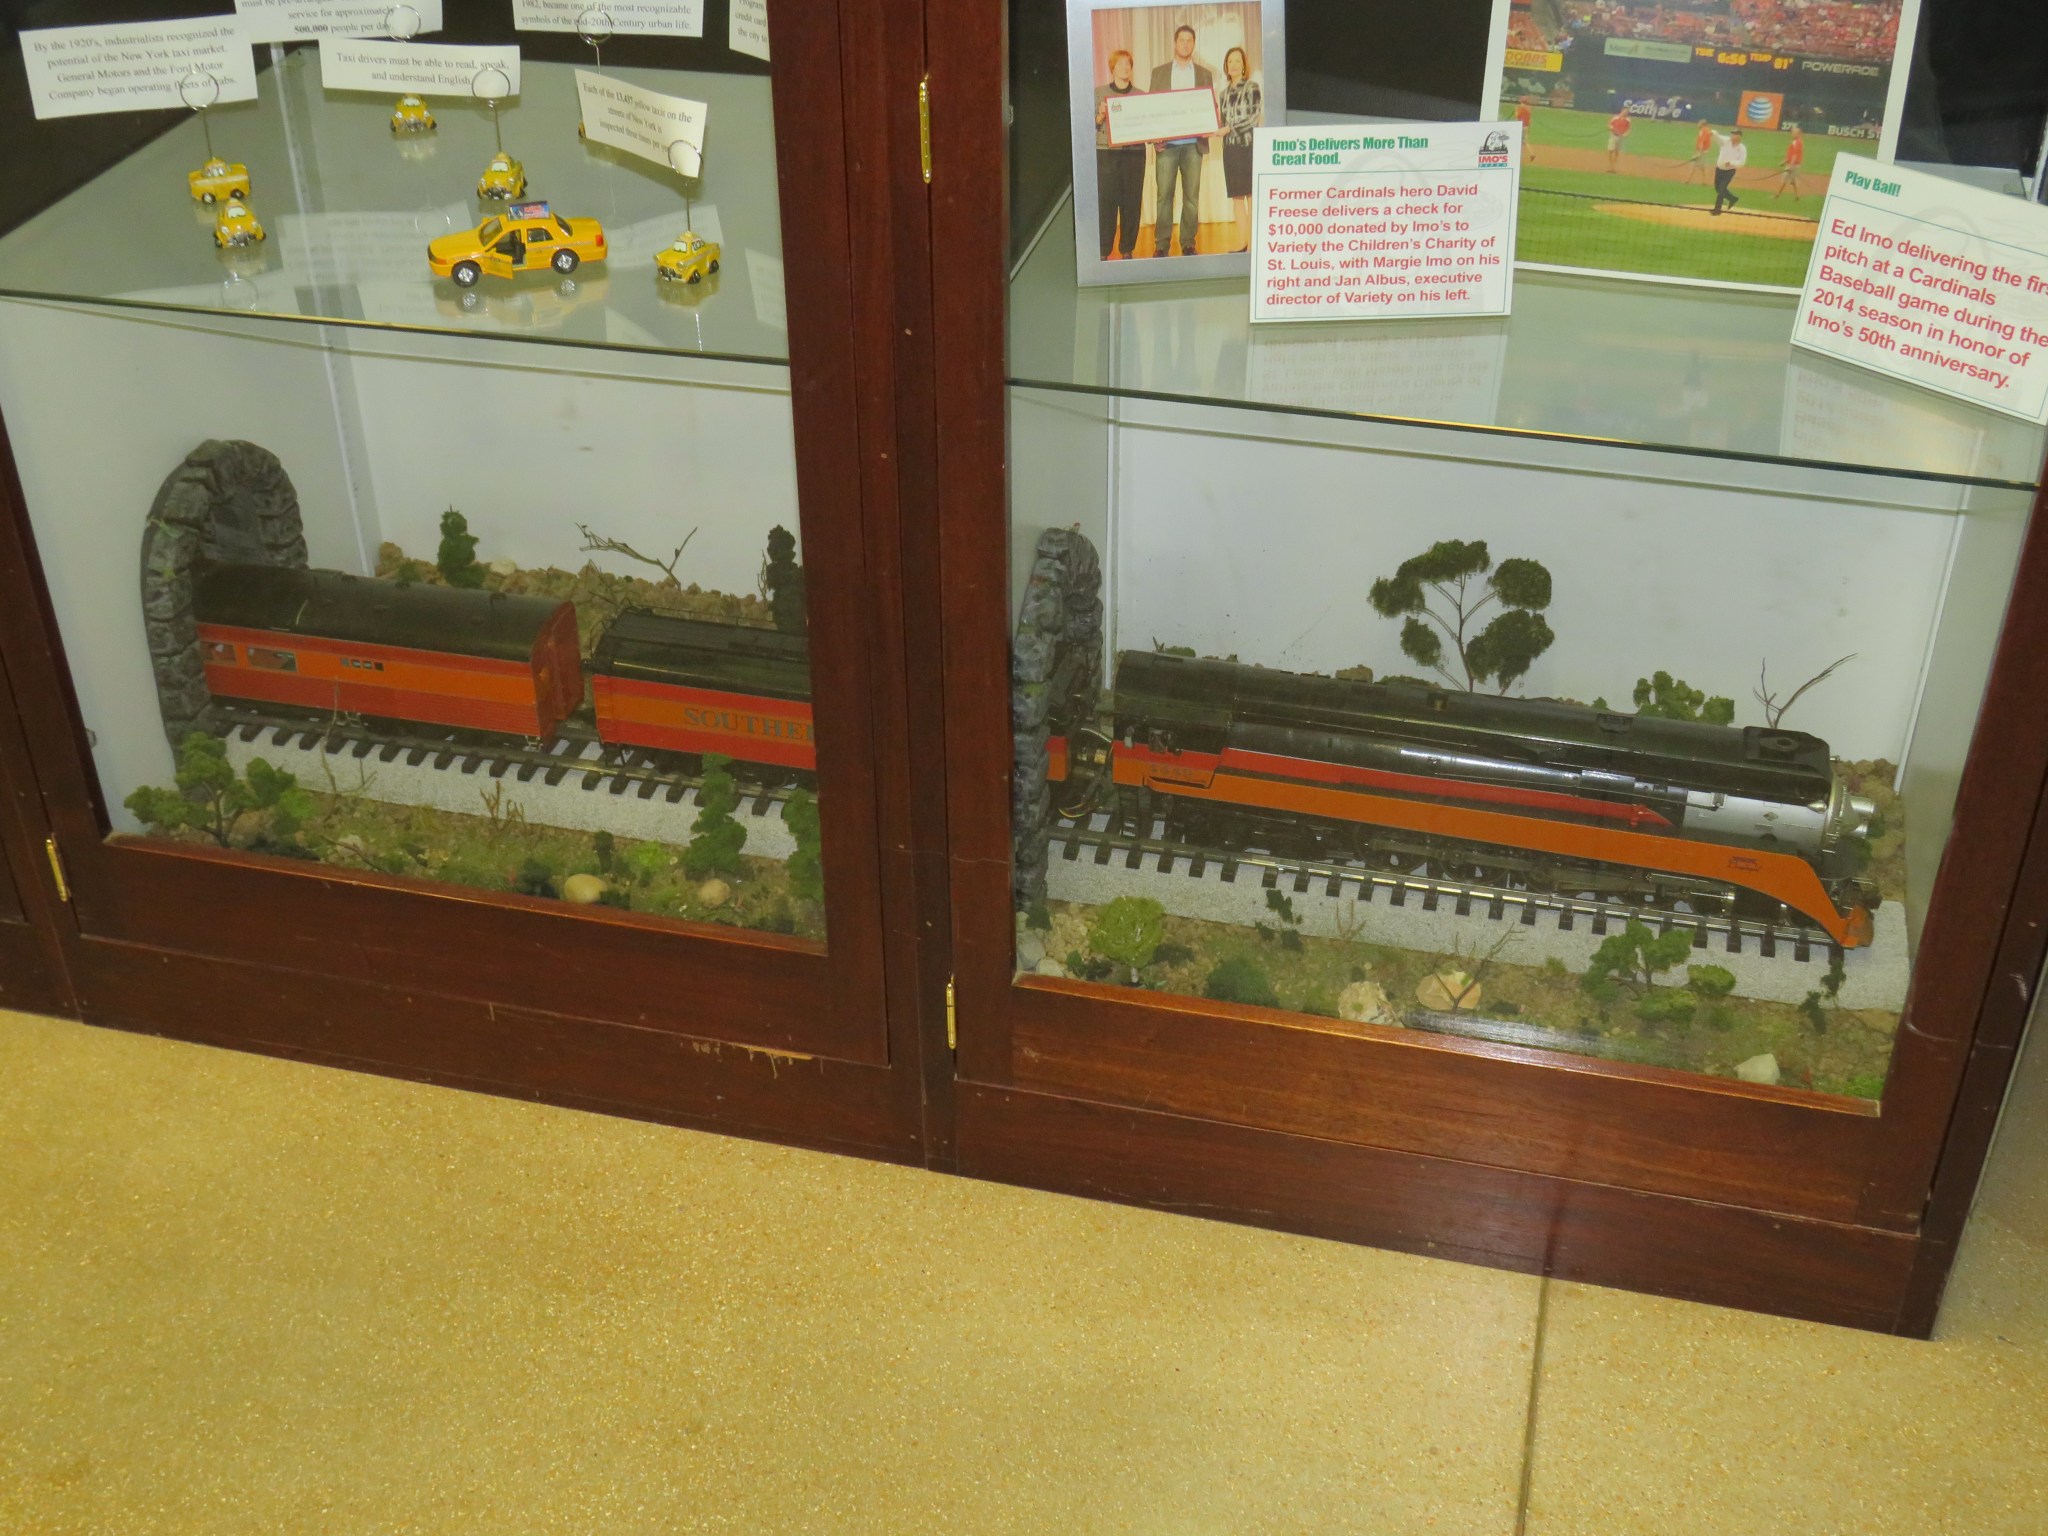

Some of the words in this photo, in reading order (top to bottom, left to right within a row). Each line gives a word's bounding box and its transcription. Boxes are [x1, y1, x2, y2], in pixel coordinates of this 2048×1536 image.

[288, 10, 318, 19] service
[320, 9, 333, 18] for
[335, 7, 395, 19] approximately
[570, 3, 585, 11] one
[614, 4, 635, 13] most
[637, 4, 691, 15] recognizable
[330, 23, 359, 34] people
[361, 24, 374, 33] per
[521, 16, 551, 26] symbols
[552, 16, 561, 25] of
[561, 17, 573, 26] the
[612, 18, 646, 30] Century
[648, 19, 673, 29] urban
[51, 40, 66, 50] the
[104, 33, 164, 46] industrialists
[166, 29, 218, 44] recognized
[220, 27, 235, 37] the
[47, 56, 89, 70] potential
[104, 52, 118, 62] the
[121, 51, 143, 61] New
[146, 49, 170, 59] York
[172, 47, 190, 58] taxi
[336, 53, 356, 63] Taxi
[357, 54, 387, 65] drivers
[389, 56, 410, 66] must
[412, 57, 423, 67] be
[424, 57, 442, 68] able
[444, 59, 454, 68] to
[57, 71, 95, 83] General
[97, 68, 132, 80] Motors
[134, 66, 150, 76] and
[152, 65, 167, 75] the
[169, 63, 192, 74] Ford
[193, 61, 224, 73] Motor
[371, 71, 387, 81] and
[389, 73, 436, 84] understand
[1802, 61, 1880, 77] POWERADE
[49, 88, 95, 101] Company
[97, 84, 126, 97] began
[128, 82, 171, 95] operating
[201, 78, 212, 89] of
[652, 105, 667, 118] taxis
[667, 111, 677, 121] on
[678, 110, 693, 123] the
[1828, 125, 1865, 138] BUSCH
[1272, 138, 1307, 152] Imo's
[1308, 137, 1361, 151] Delivers
[1362, 136, 1395, 150] More
[1397, 135, 1429, 149] Than
[1272, 153, 1307, 166] Great
[1308, 152, 1341, 166] Food.
[1478, 155, 1508, 164] IMO'S
[1269, 188, 1322, 201] Former
[1326, 185, 1396, 200] Cardinals
[1399, 185, 1433, 198] hero
[1437, 183, 1478, 197] David
[1844, 170, 1872, 191] Play
[1871, 178, 1902, 198] Ball!
[1268, 205, 1318, 218] Freese
[1322, 203, 1379, 217] delivers
[1383, 206, 1392, 216] a
[1395, 202, 1440, 216] check
[1443, 201, 1464, 214] for
[1268, 222, 1323, 237] $10,000
[1327, 221, 1387, 235] donated
[1390, 221, 1408, 237] by
[1412, 219, 1451, 233] Imo's
[1455, 220, 1470, 231] to
[1267, 240, 1318, 255] Variety
[1321, 239, 1345, 252] the
[1347, 238, 1421, 252] Children's
[1425, 236, 1477, 251] Charity
[1480, 235, 1496, 248] of
[1267, 258, 1286, 271] St.
[1290, 257, 1335, 272] Louis,
[1339, 256, 1369, 269] with
[1373, 255, 1422, 271] Margie
[1425, 254, 1453, 267] Imo
[1456, 255, 1475, 266] on
[1479, 253, 1501, 266] his
[1831, 218, 1857, 239] Ed
[1859, 226, 1894, 250] Imo
[1897, 240, 1988, 281] delivering
[1991, 266, 2022, 287] the
[2027, 275, 2048, 296] fir
[1266, 276, 1301, 291] right
[1304, 275, 1332, 288] and
[1334, 275, 1361, 287] Jan
[1364, 273, 1411, 287] Albus,
[1414, 271, 1483, 285] executive
[1824, 244, 1869, 269] pitch
[1872, 258, 1891, 275] at
[1893, 265, 1905, 279] a
[1908, 267, 1998, 306] Cardinals
[1266, 292, 1322, 306] director
[1326, 292, 1342, 304] of
[1344, 290, 1394, 306] Variety
[1397, 292, 1416, 303] on
[1419, 289, 1442, 302] his
[1445, 288, 1471, 301] left.
[1819, 265, 1896, 301] Baseball
[1897, 292, 1950, 318] game
[1953, 307, 2016, 341] during
[2019, 326, 2048, 348] the
[1812, 288, 1855, 313] 2014
[1857, 304, 1924, 335] season
[1926, 322, 1944, 341] in
[1947, 330, 2006, 360] honor
[2008, 350, 2032, 367] of
[1807, 310, 1855, 338] Imo's
[1857, 326, 1897, 351] 50th
[1899, 342, 2011, 389] anniversary.
